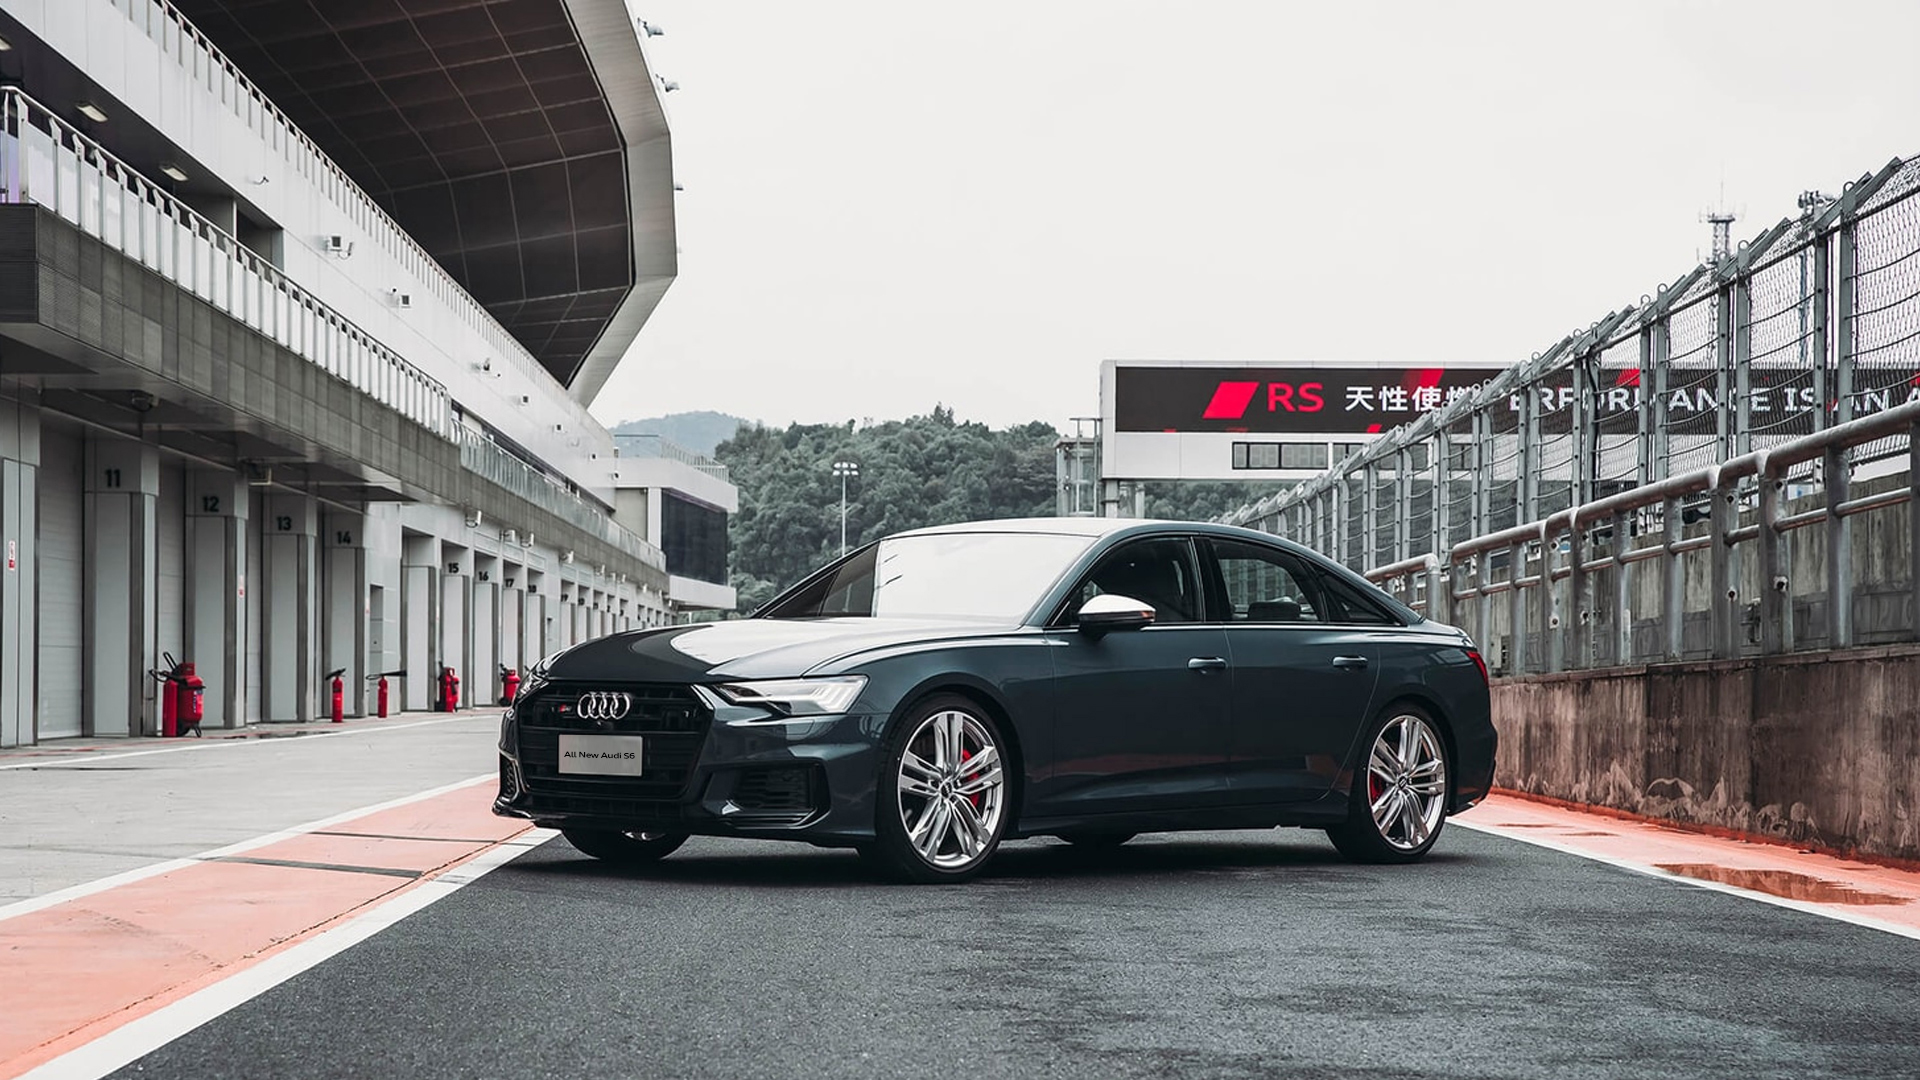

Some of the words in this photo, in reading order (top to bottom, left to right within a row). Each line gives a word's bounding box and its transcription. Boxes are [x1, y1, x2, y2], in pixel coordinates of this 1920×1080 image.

[1267, 382, 1324, 412] RS
[104, 468, 121, 489] 11
[202, 496, 219, 513] 12
[276, 516, 292, 531] 13
[336, 530, 351, 545] 14
[448, 562, 459, 573] 15
[478, 571, 489, 581] 16
[505, 578, 514, 587] 17
[579, 751, 599, 759] New
[623, 752, 636, 760] S6
